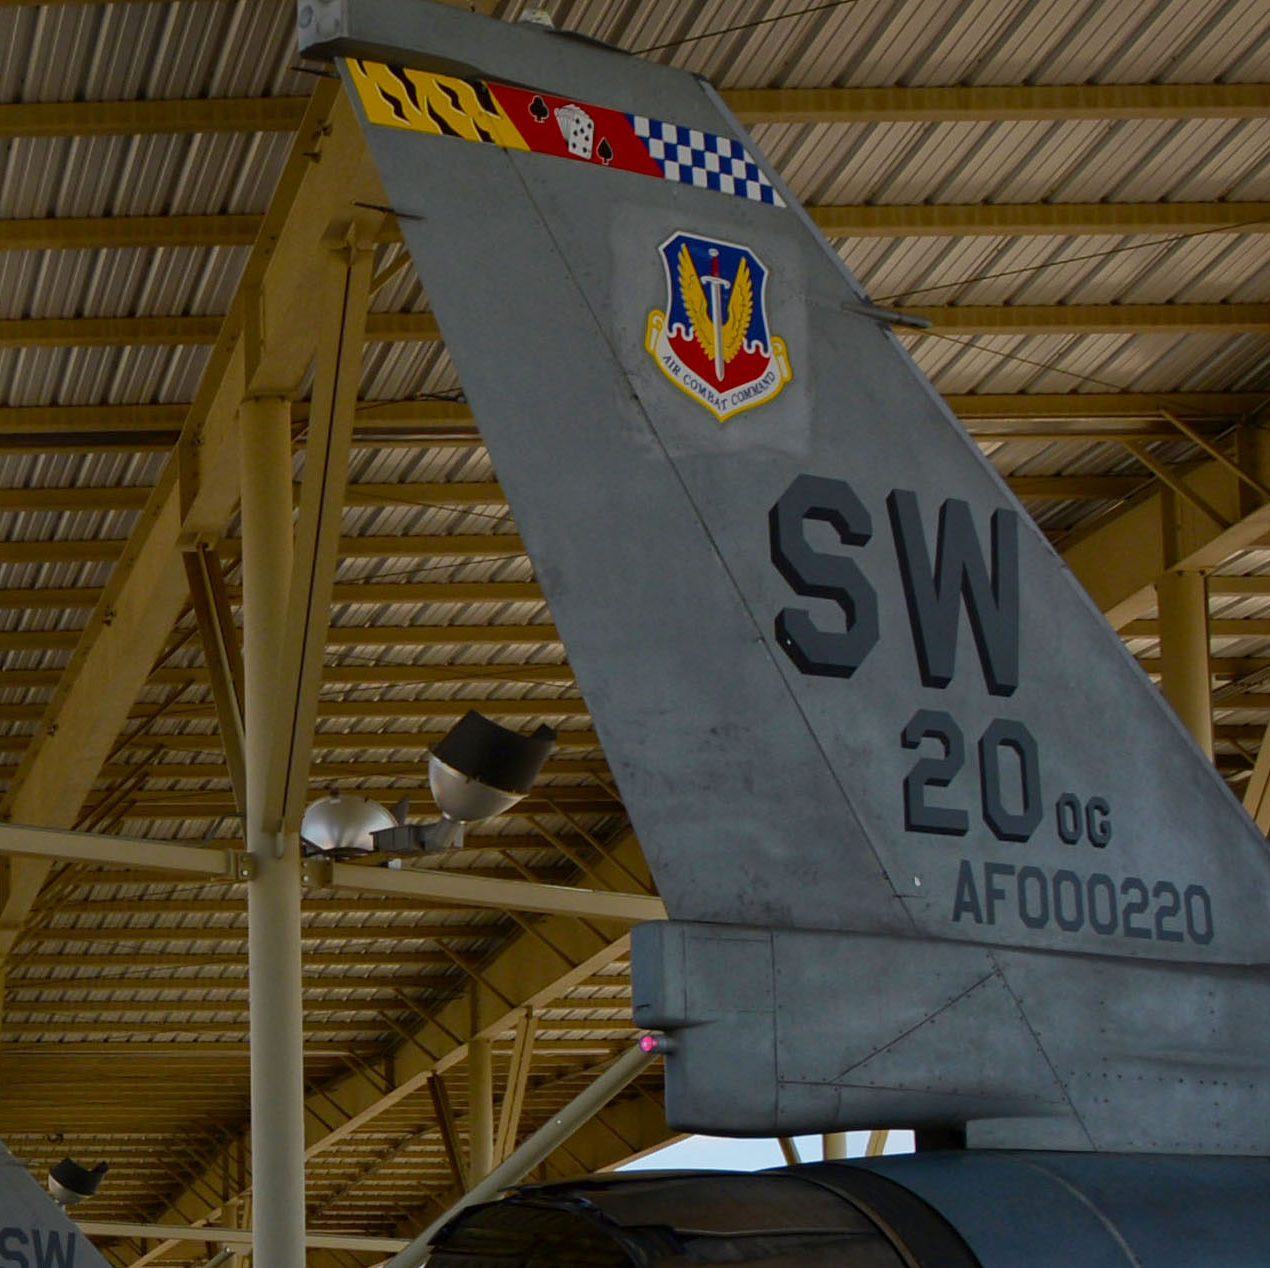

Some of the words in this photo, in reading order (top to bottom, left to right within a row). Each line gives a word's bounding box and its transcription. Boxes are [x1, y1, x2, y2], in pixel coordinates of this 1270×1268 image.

[662, 354, 681, 376] AIR
[683, 374, 727, 410] COMBAT
[731, 371, 775, 405] COMMAND
[769, 474, 1019, 698] SW
[900, 709, 1043, 843] 20
[1055, 793, 1112, 848] OG
[952, 860, 1214, 945] AF000220
